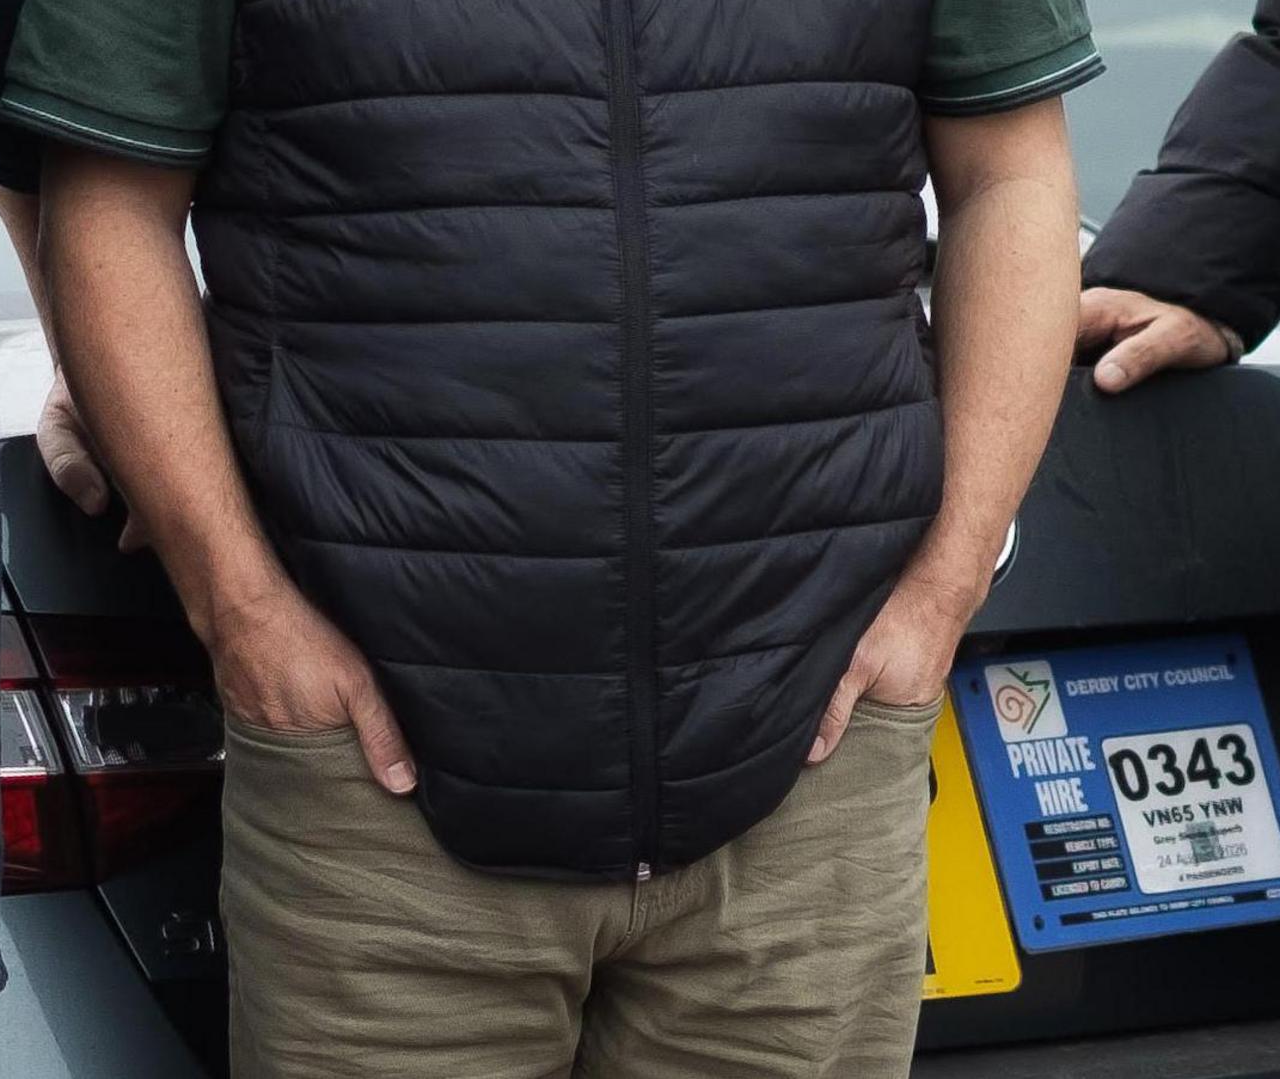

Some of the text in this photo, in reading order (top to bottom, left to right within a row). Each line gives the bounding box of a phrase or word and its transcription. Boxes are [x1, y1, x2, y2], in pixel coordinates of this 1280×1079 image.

[1066, 665, 1235, 697] DERBY CITY COUNCIL
[1006, 736, 1096, 779] PRIVATE
[1108, 733, 1256, 801] 0343
[1035, 778, 1089, 817] HIRE
[1142, 796, 1244, 828] VN65 YNW
[1157, 854, 1172, 868] 24
